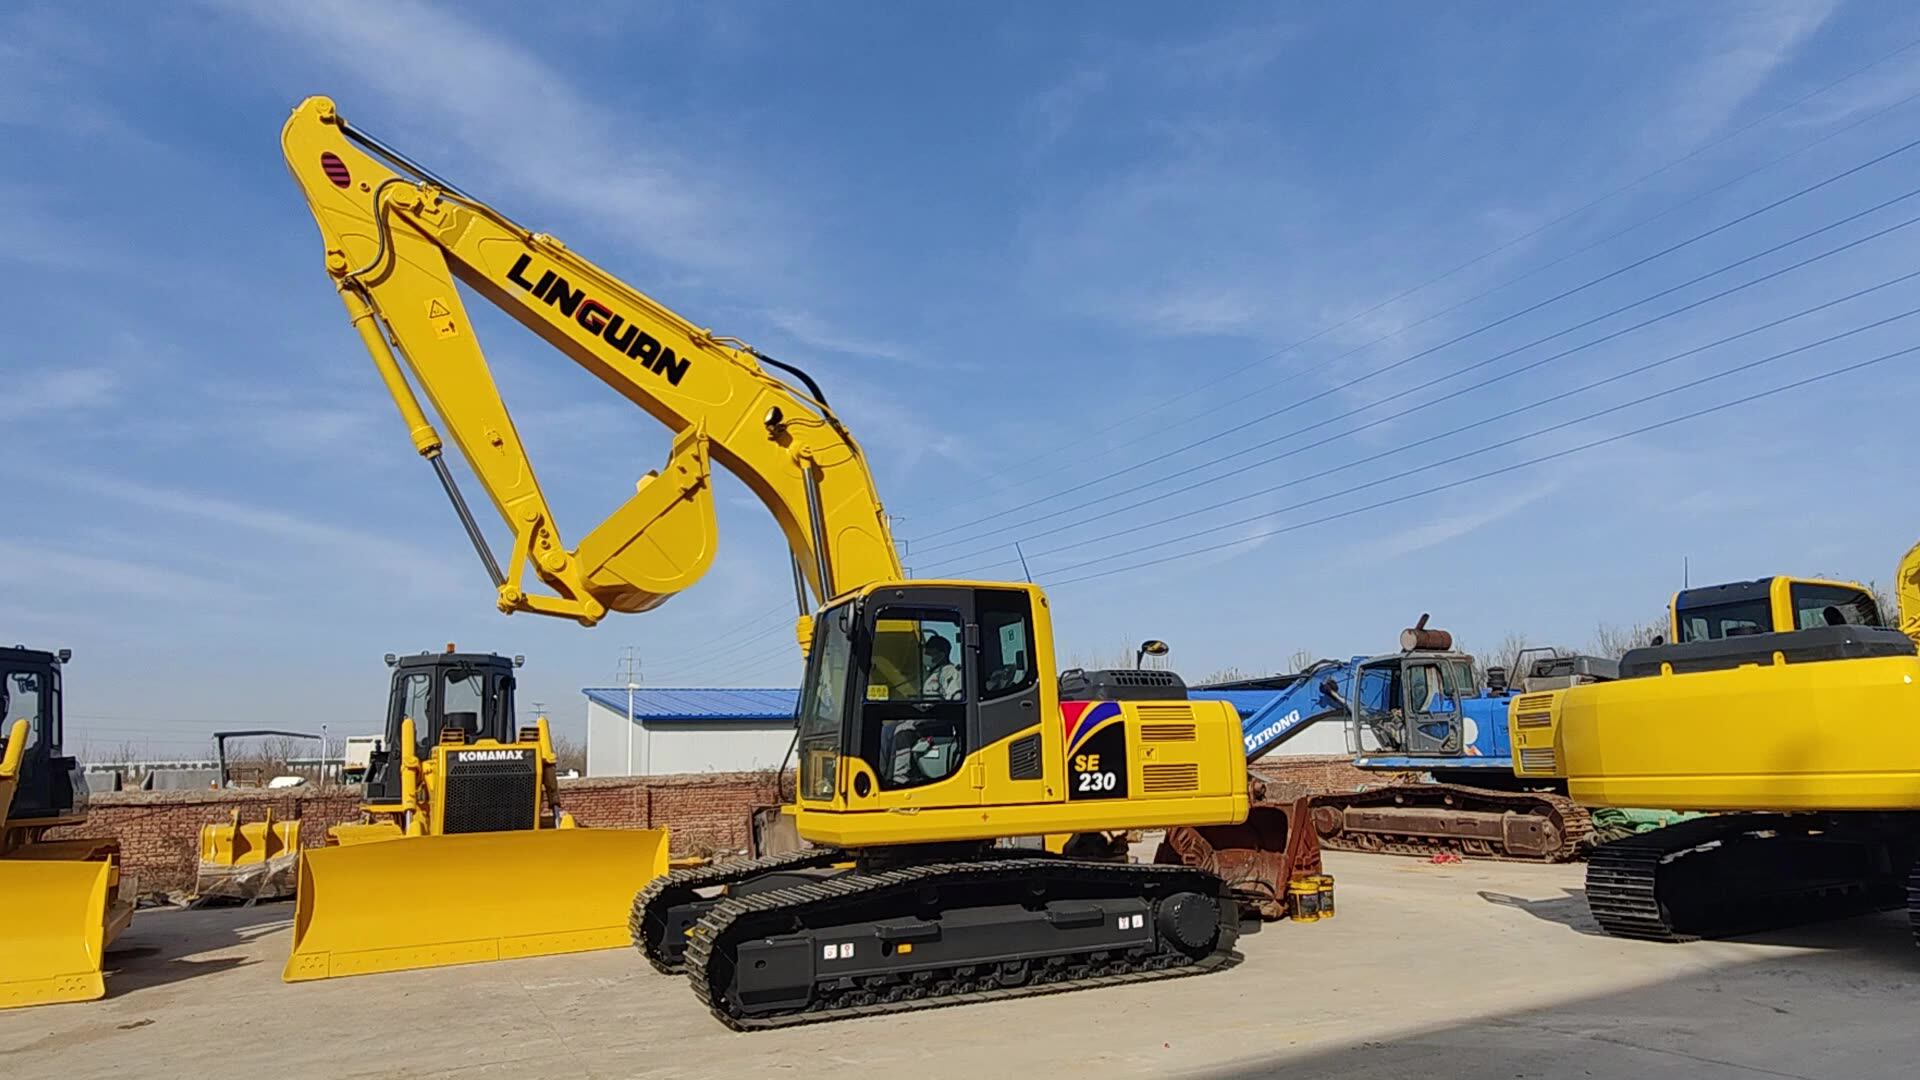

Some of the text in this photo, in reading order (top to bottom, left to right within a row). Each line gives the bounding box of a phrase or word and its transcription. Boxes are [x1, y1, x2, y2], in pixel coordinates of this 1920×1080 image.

[506, 252, 692, 387] LINGUAN
[458, 750, 523, 762] KOMAMAX
[1073, 753, 1100, 772] SE
[1078, 772, 1116, 791] 230
